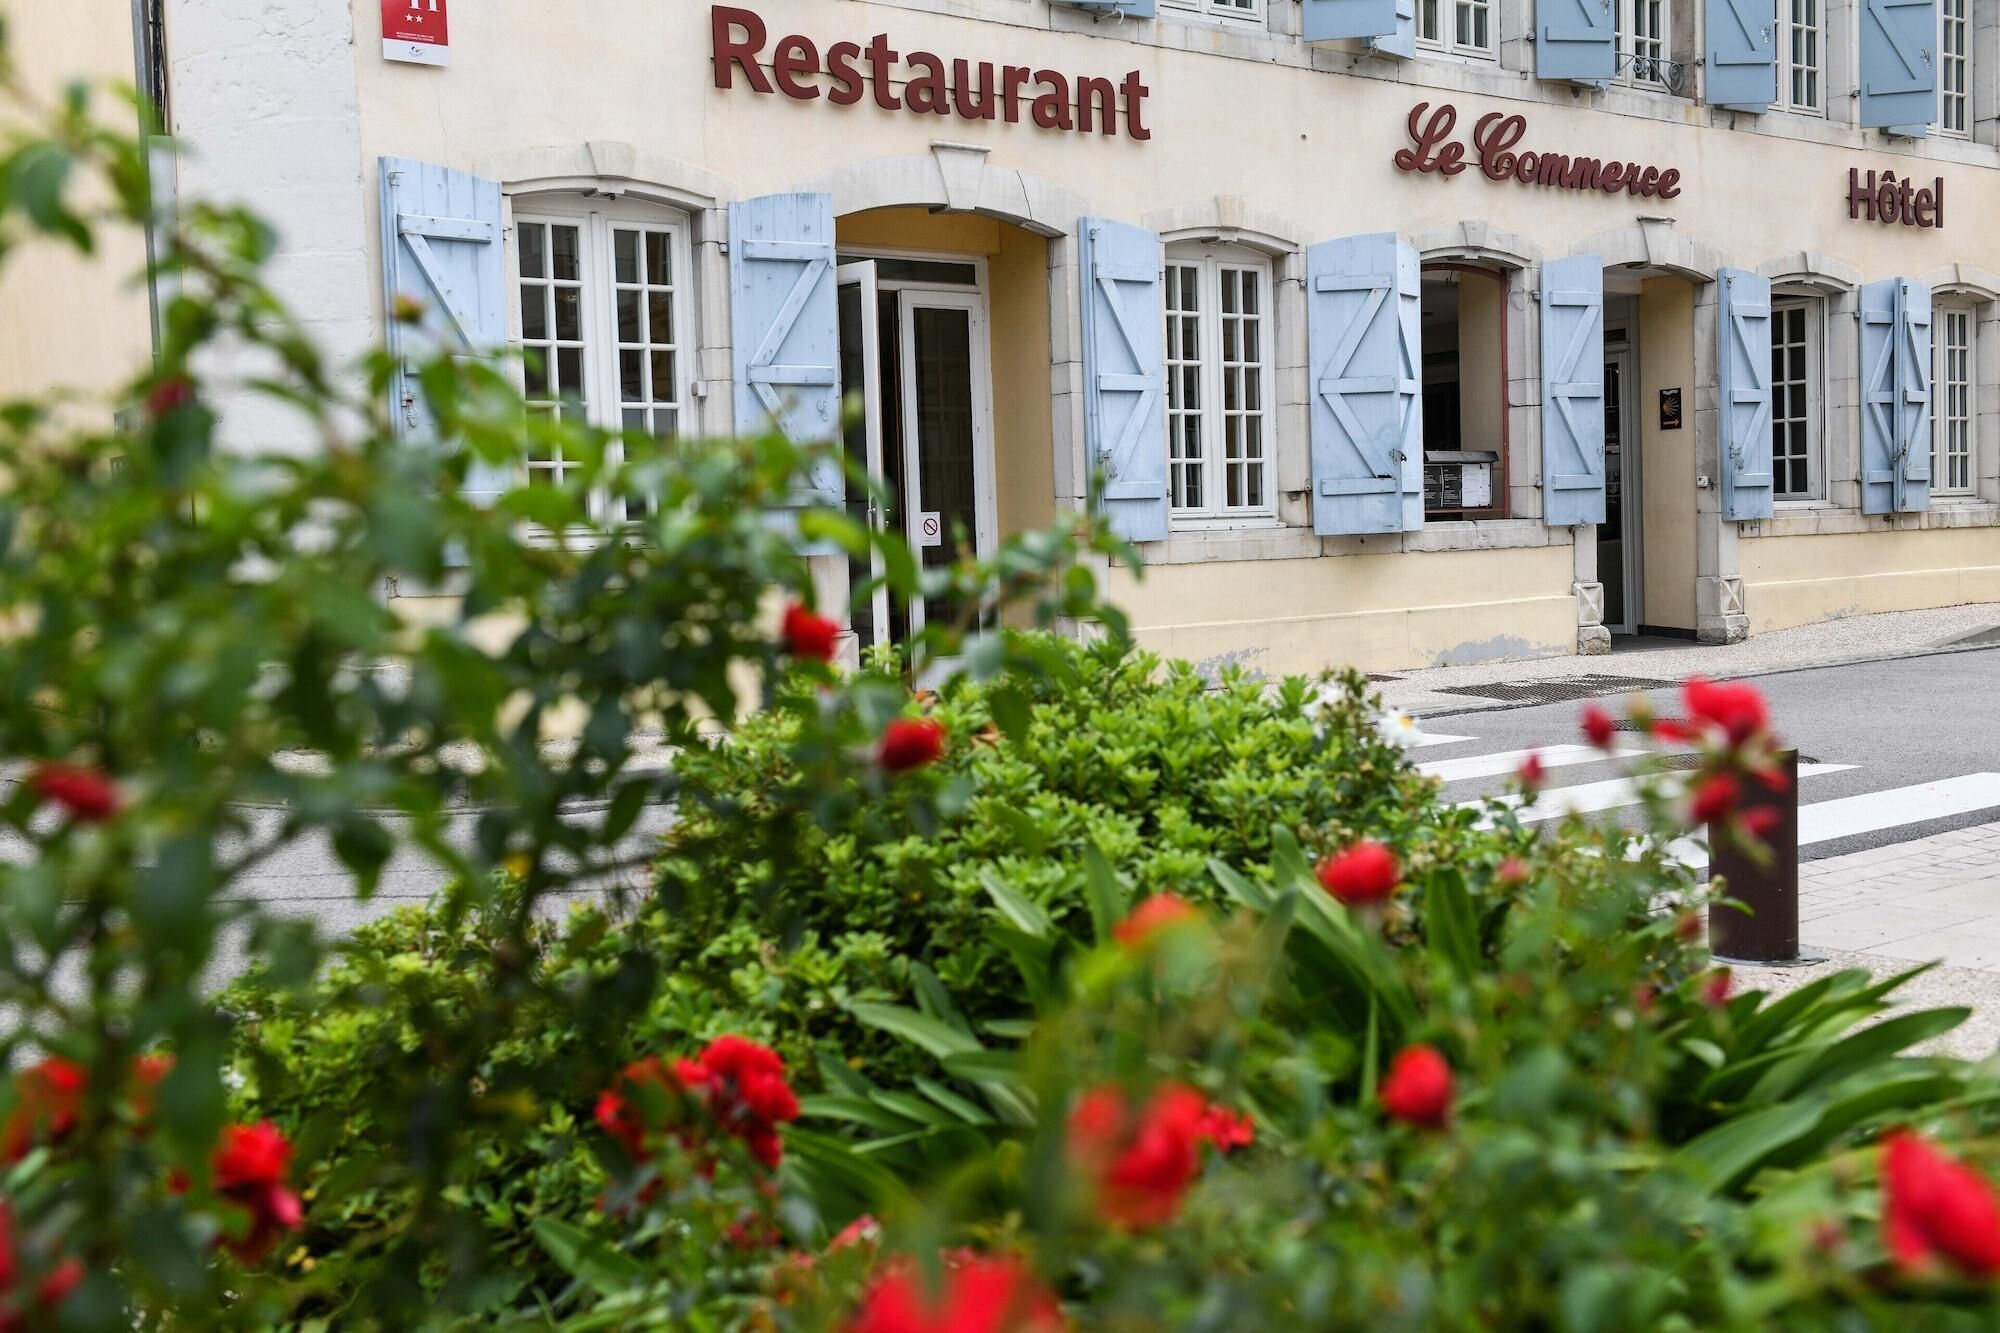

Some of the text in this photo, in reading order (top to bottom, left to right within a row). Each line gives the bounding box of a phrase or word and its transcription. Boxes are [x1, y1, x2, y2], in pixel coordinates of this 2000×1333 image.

[711, 5, 1151, 141] Restaurant
[1395, 102, 1681, 200] Le Commerce
[1848, 167, 1945, 229] Hôtel
